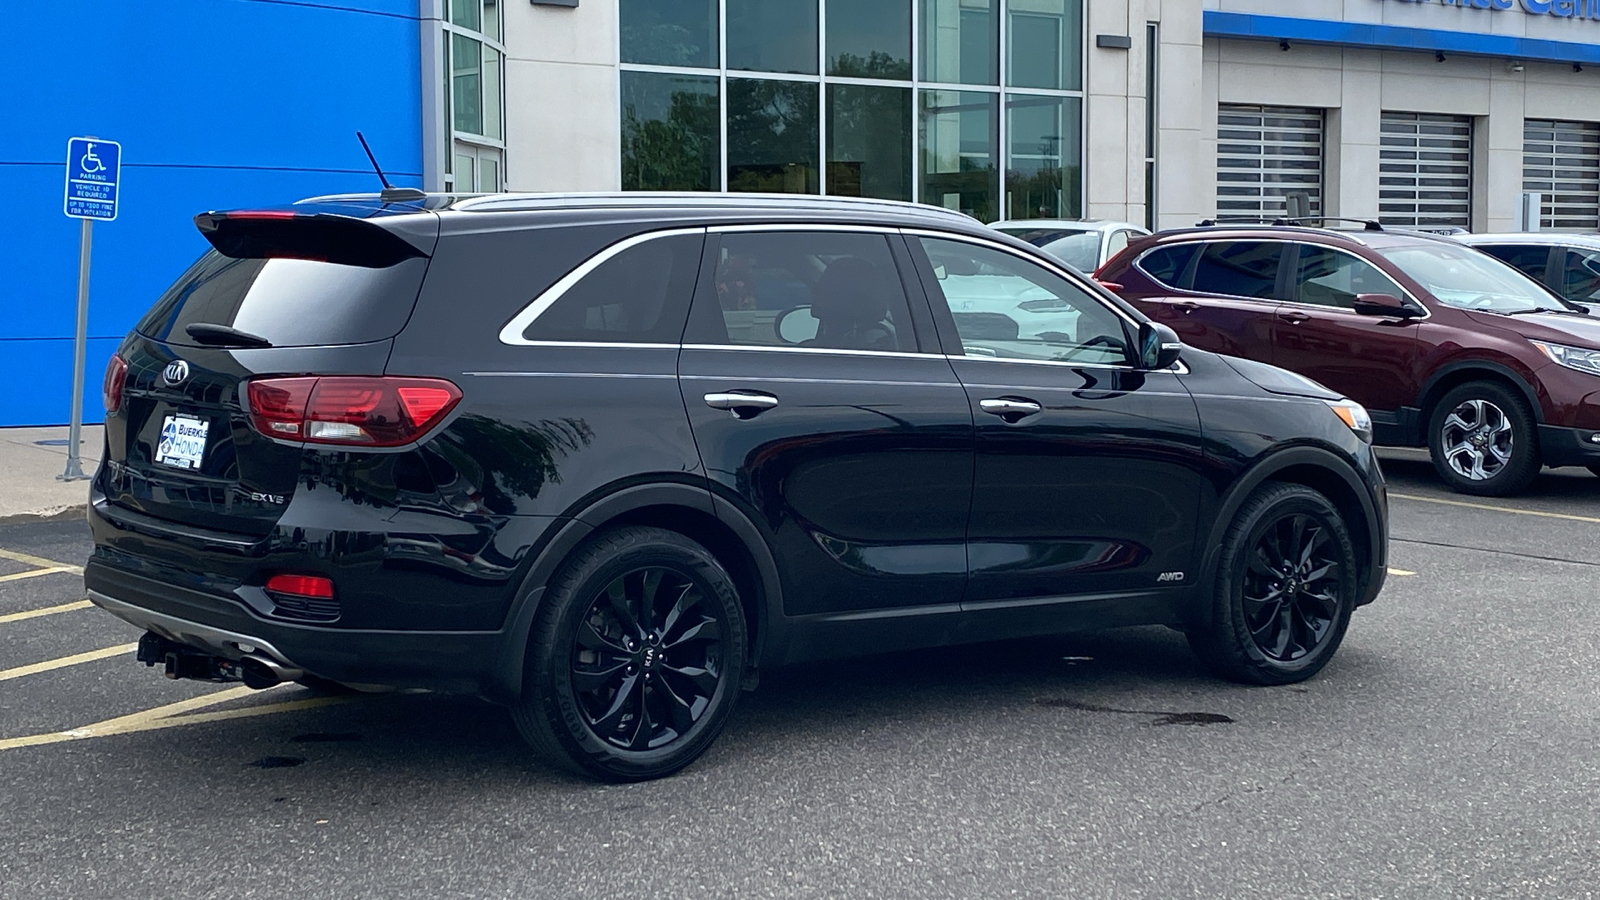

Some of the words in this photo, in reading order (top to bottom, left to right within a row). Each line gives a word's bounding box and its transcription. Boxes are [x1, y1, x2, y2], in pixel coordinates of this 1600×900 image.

[80, 172, 107, 181] PARKING
[75, 183, 101, 192] VEHICLE
[77, 190, 107, 199] REQUIRED
[83, 209, 112, 217] VIOLATION
[173, 437, 204, 456] HONDA
[251, 492, 268, 502] EX
[1156, 571, 1184, 582] AWD
[644, 649, 654, 667] KIA
